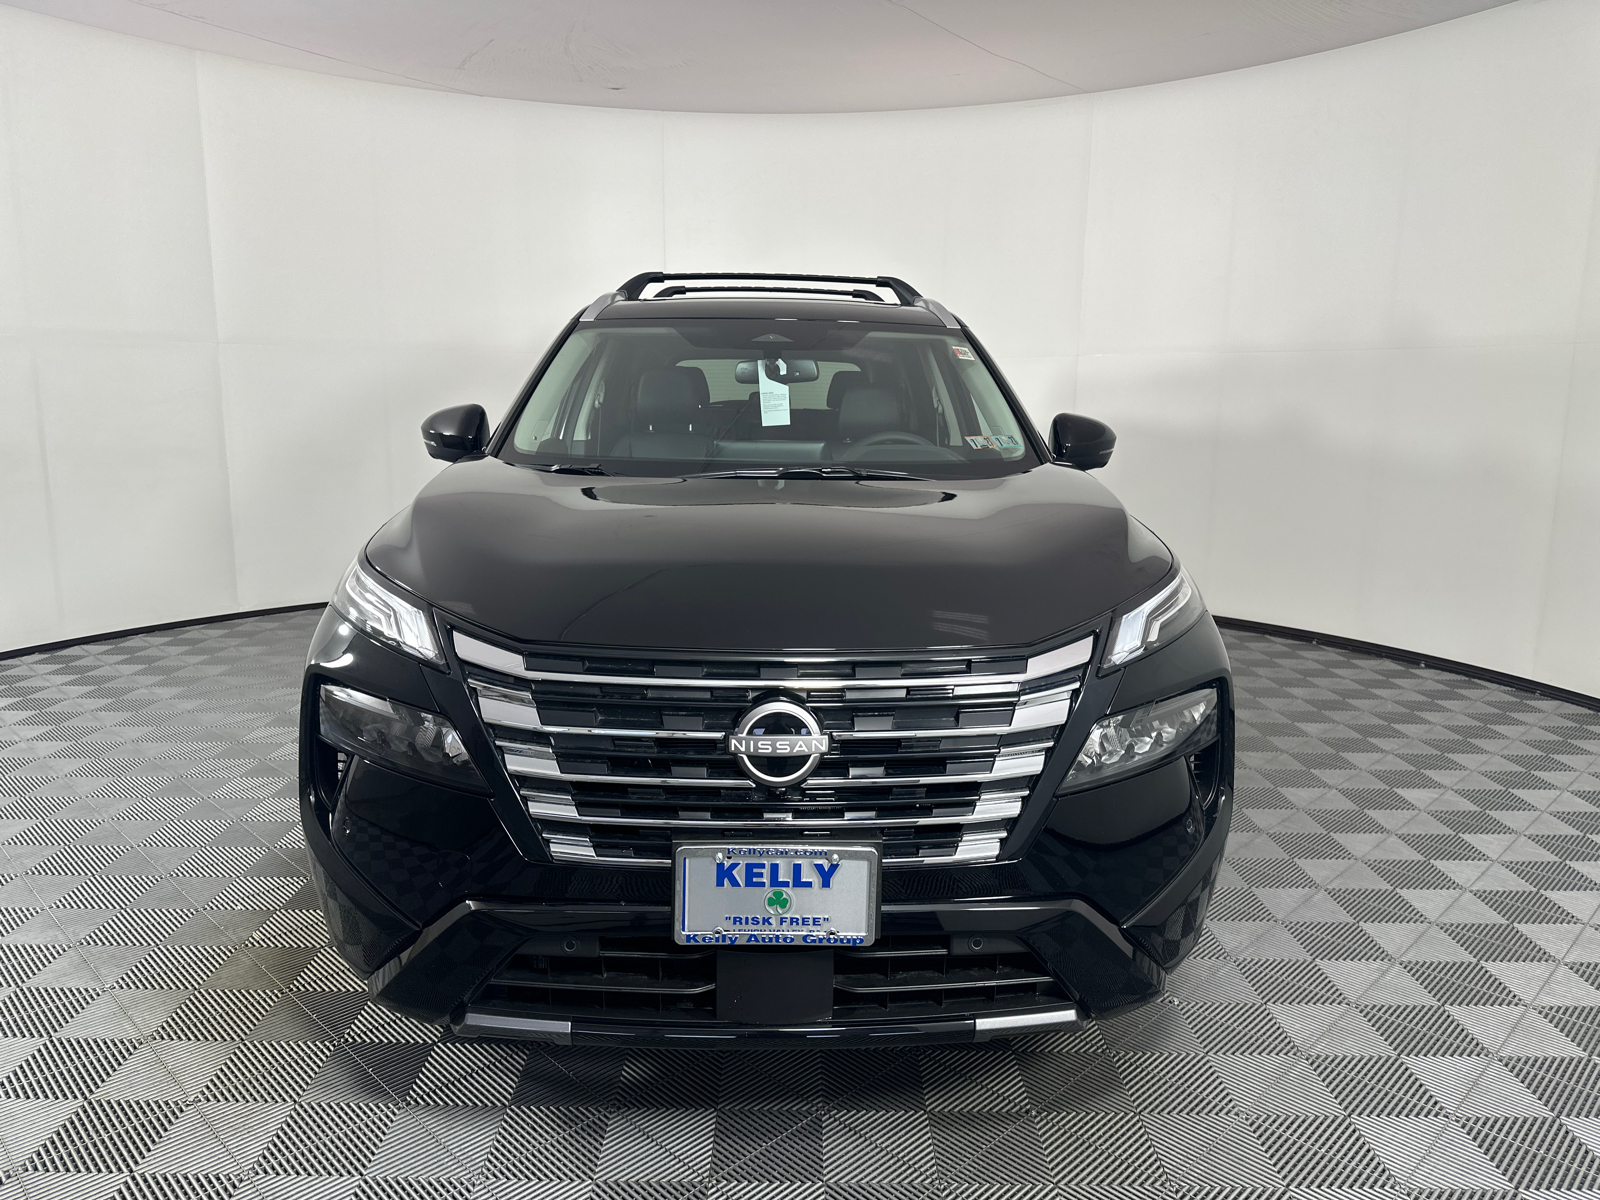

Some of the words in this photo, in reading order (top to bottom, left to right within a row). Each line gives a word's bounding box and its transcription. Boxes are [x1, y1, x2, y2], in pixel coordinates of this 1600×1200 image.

[731, 738, 826, 753] NISSAN
[727, 847, 828, 858] Kellycar.com
[715, 862, 841, 888] KELLY
[725, 916, 773, 926] "RISK
[779, 916, 830, 927] FREE"
[685, 933, 739, 946] Kelly
[746, 933, 795, 944] Auto
[802, 934, 865, 947] Group
